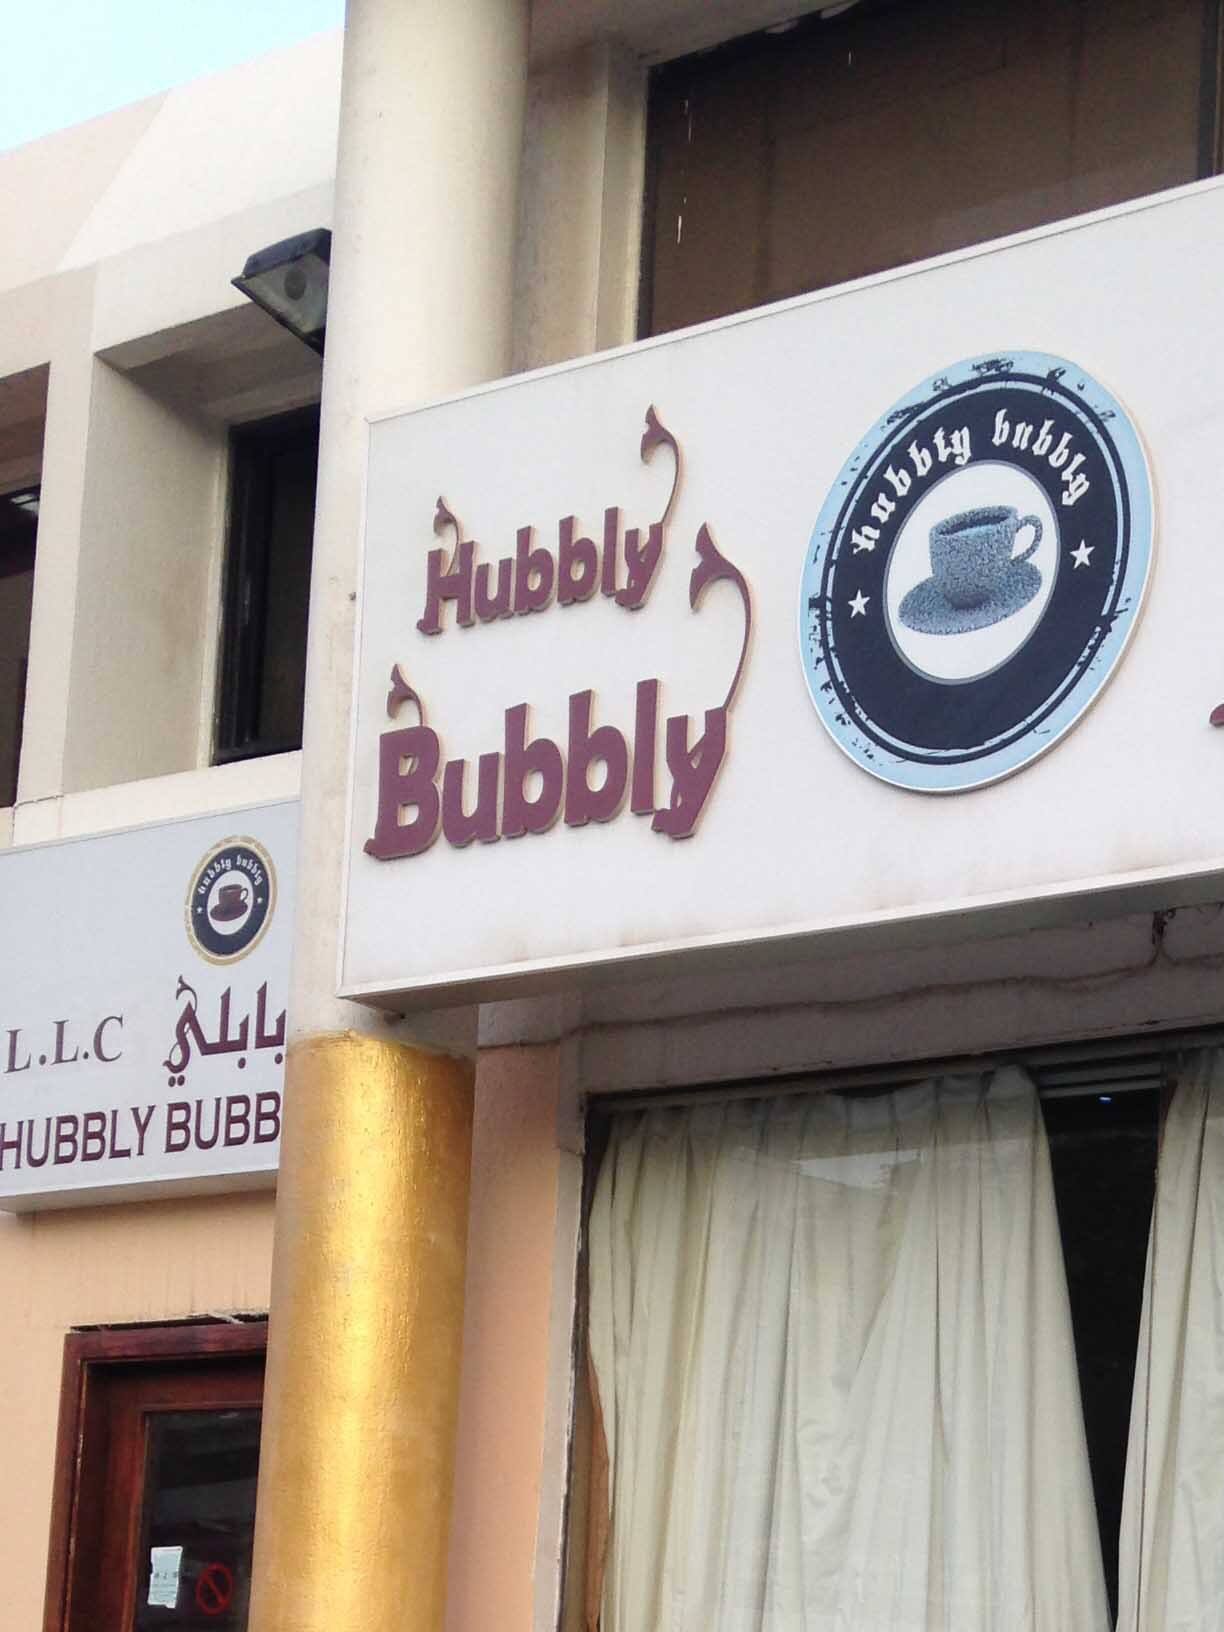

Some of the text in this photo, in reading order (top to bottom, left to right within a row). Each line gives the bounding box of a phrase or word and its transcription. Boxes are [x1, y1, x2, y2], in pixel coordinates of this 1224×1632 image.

[991, 408, 1091, 506] bubbly
[416, 403, 683, 635] Hubbly
[363, 521, 752, 861] Bubbly
[162, 974, 287, 1087] بابلي
[0, 1104, 156, 1171] HUBBLY
